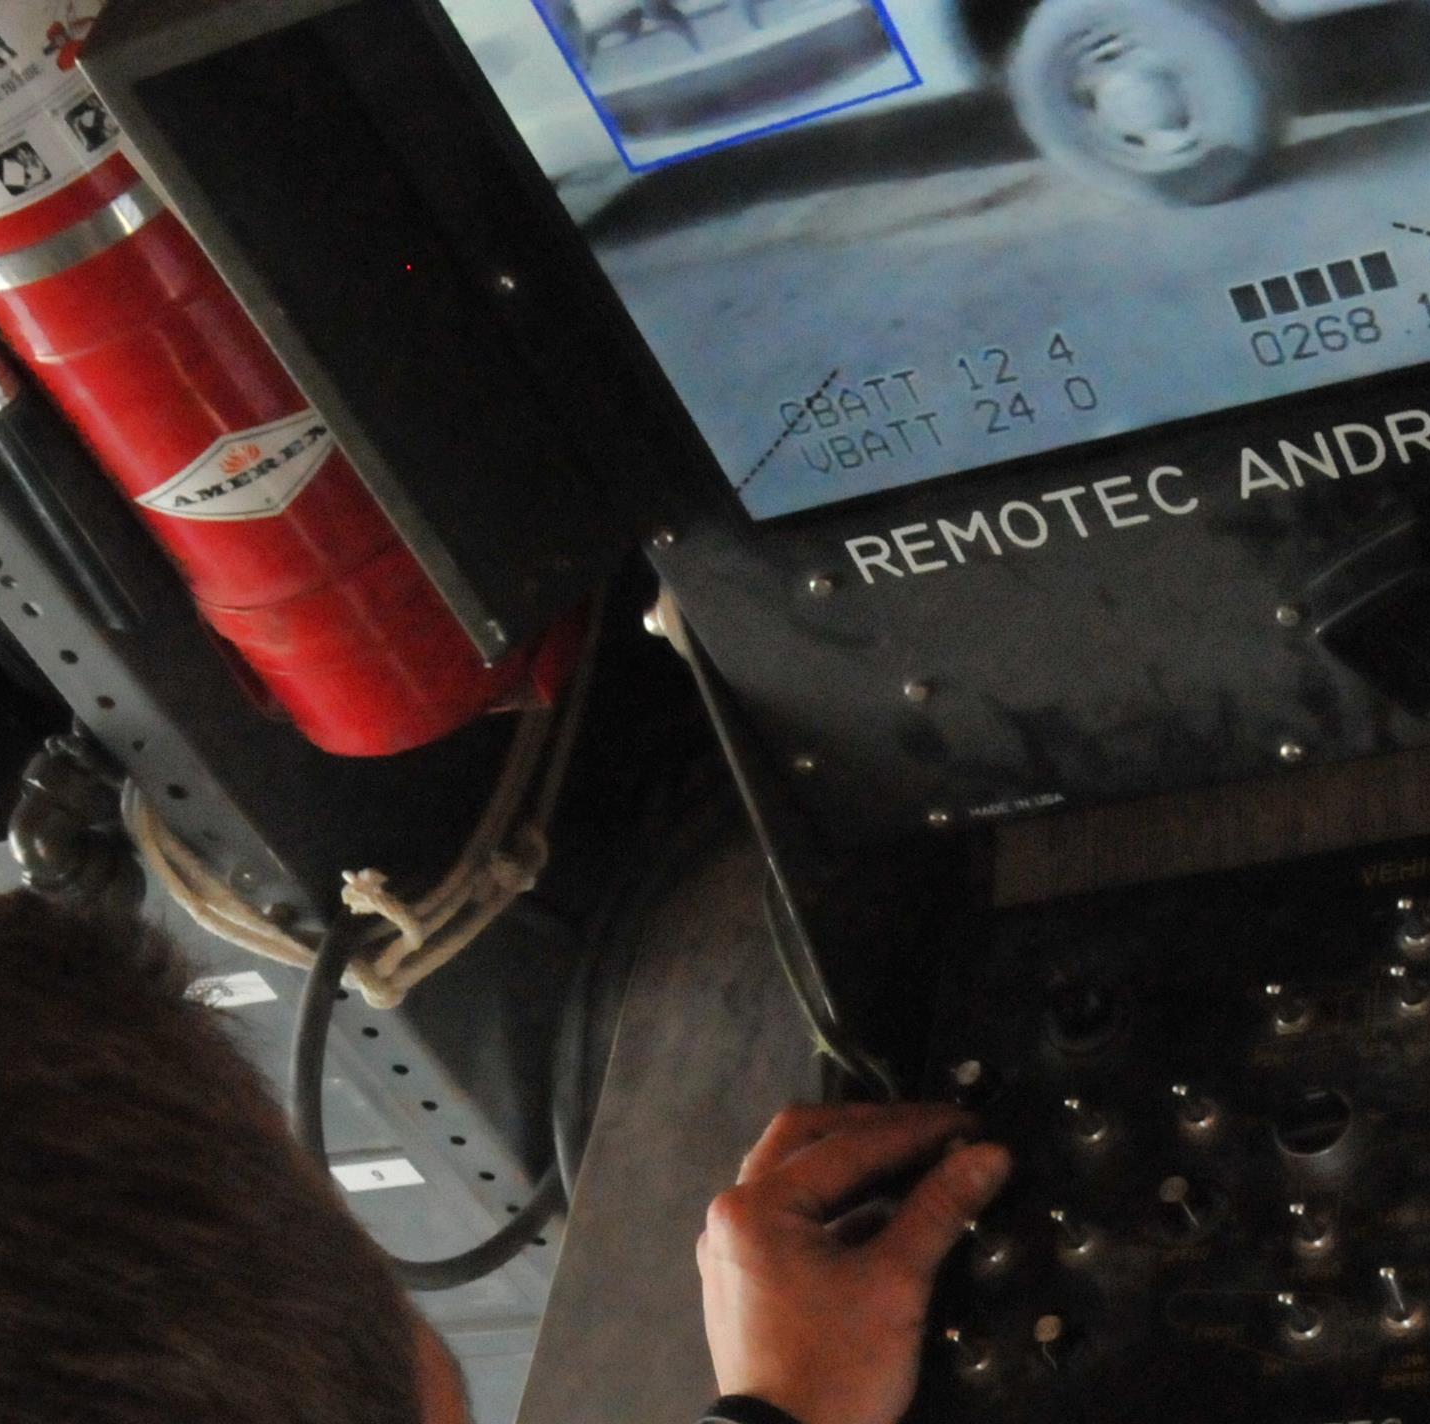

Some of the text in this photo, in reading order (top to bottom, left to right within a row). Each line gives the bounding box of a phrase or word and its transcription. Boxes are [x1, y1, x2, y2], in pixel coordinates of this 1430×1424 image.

[779, 370, 920, 435] CBATT
[801, 412, 942, 474] VBATT
[844, 465, 1200, 585] REMOTEC
